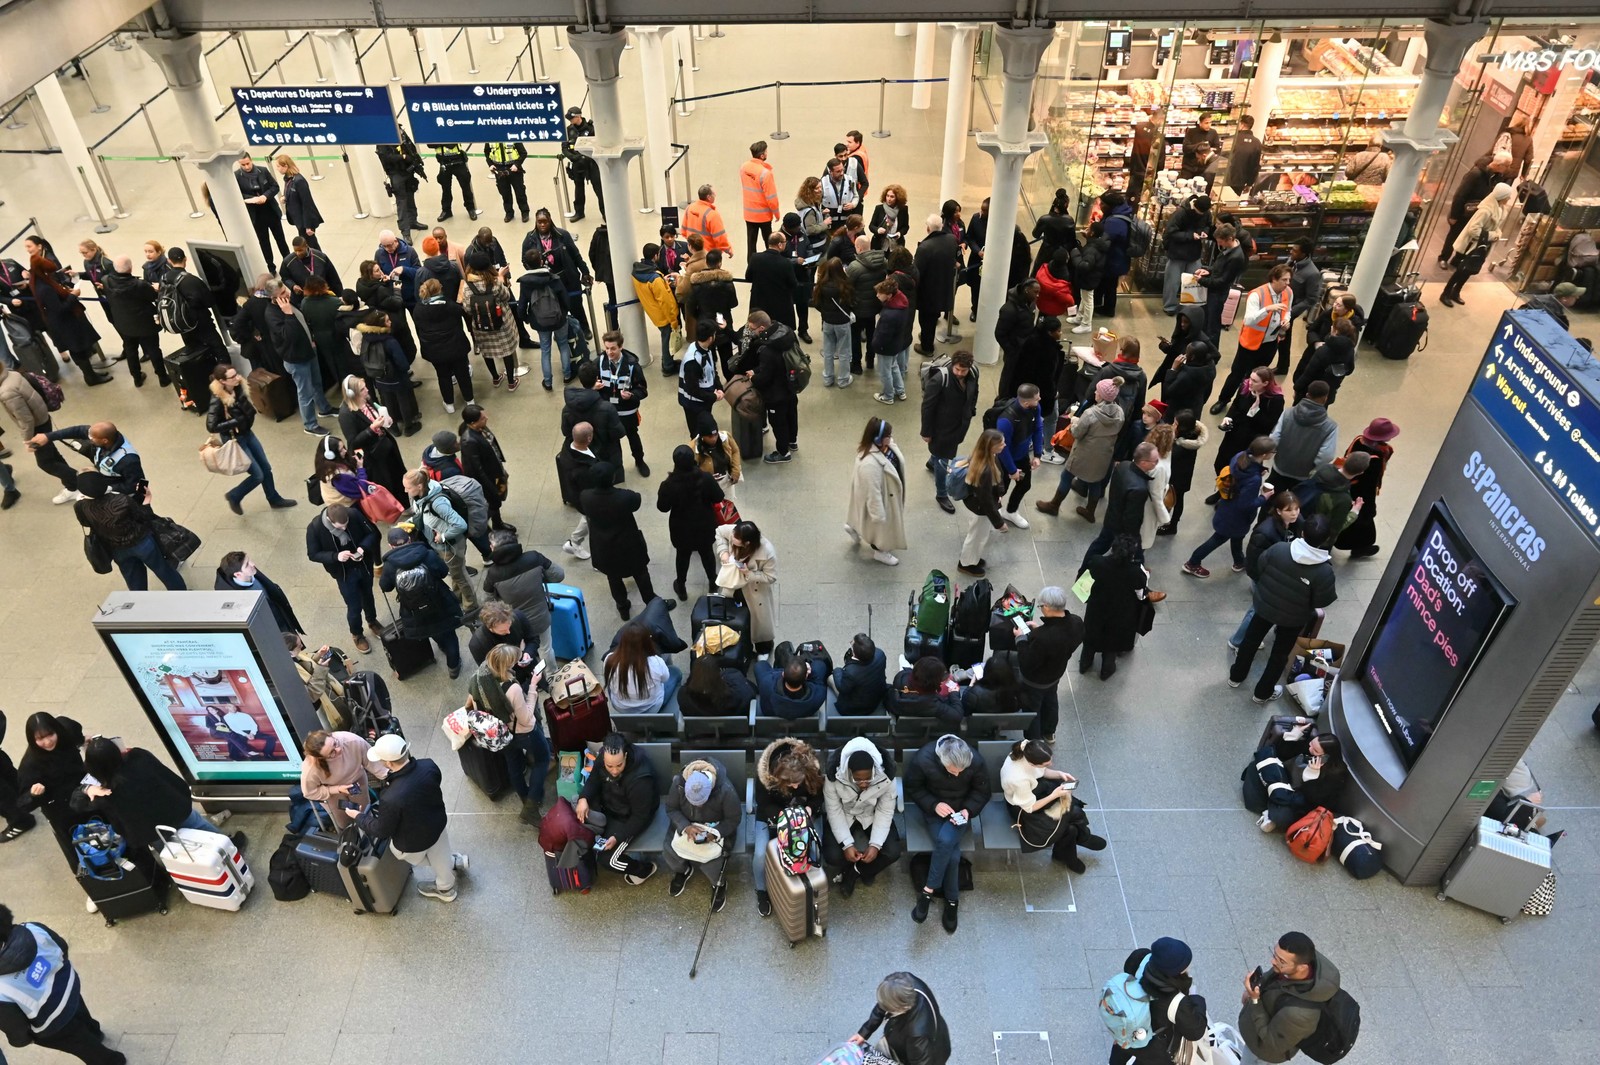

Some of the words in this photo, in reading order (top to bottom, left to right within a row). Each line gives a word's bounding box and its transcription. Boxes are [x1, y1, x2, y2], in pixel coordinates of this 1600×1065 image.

[1499, 50, 1555, 72] M&S
[250, 89, 298, 100] Departures
[299, 88, 333, 100] Départs
[254, 104, 291, 114] National
[291, 104, 308, 114] Rail
[432, 102, 459, 111] Billets
[460, 101, 515, 111] International
[515, 101, 544, 110] tickets
[486, 86, 542, 97] Underground
[259, 119, 278, 130] Way
[279, 120, 294, 128] out
[477, 116, 512, 126] Arrivées
[514, 116, 547, 125] Arrivals
[1513, 334, 1569, 397] Underground
[1496, 373, 1514, 401] Way
[1511, 395, 1528, 414] out
[1504, 355, 1537, 395] Arrivals
[1534, 388, 1572, 432] Arrivées
[1566, 483, 1598, 525] Toilets
[1430, 530, 1458, 575] Drop
[1457, 573, 1477, 599] off
[1488, 519, 1530, 572] INTERNATIONAL
[1414, 565, 1443, 612] Dad's
[1422, 548, 1466, 616] location:
[1406, 584, 1437, 632] mince
[1433, 630, 1459, 667] pies
[1395, 715, 1403, 728] on
[1401, 724, 1414, 747] Uber
